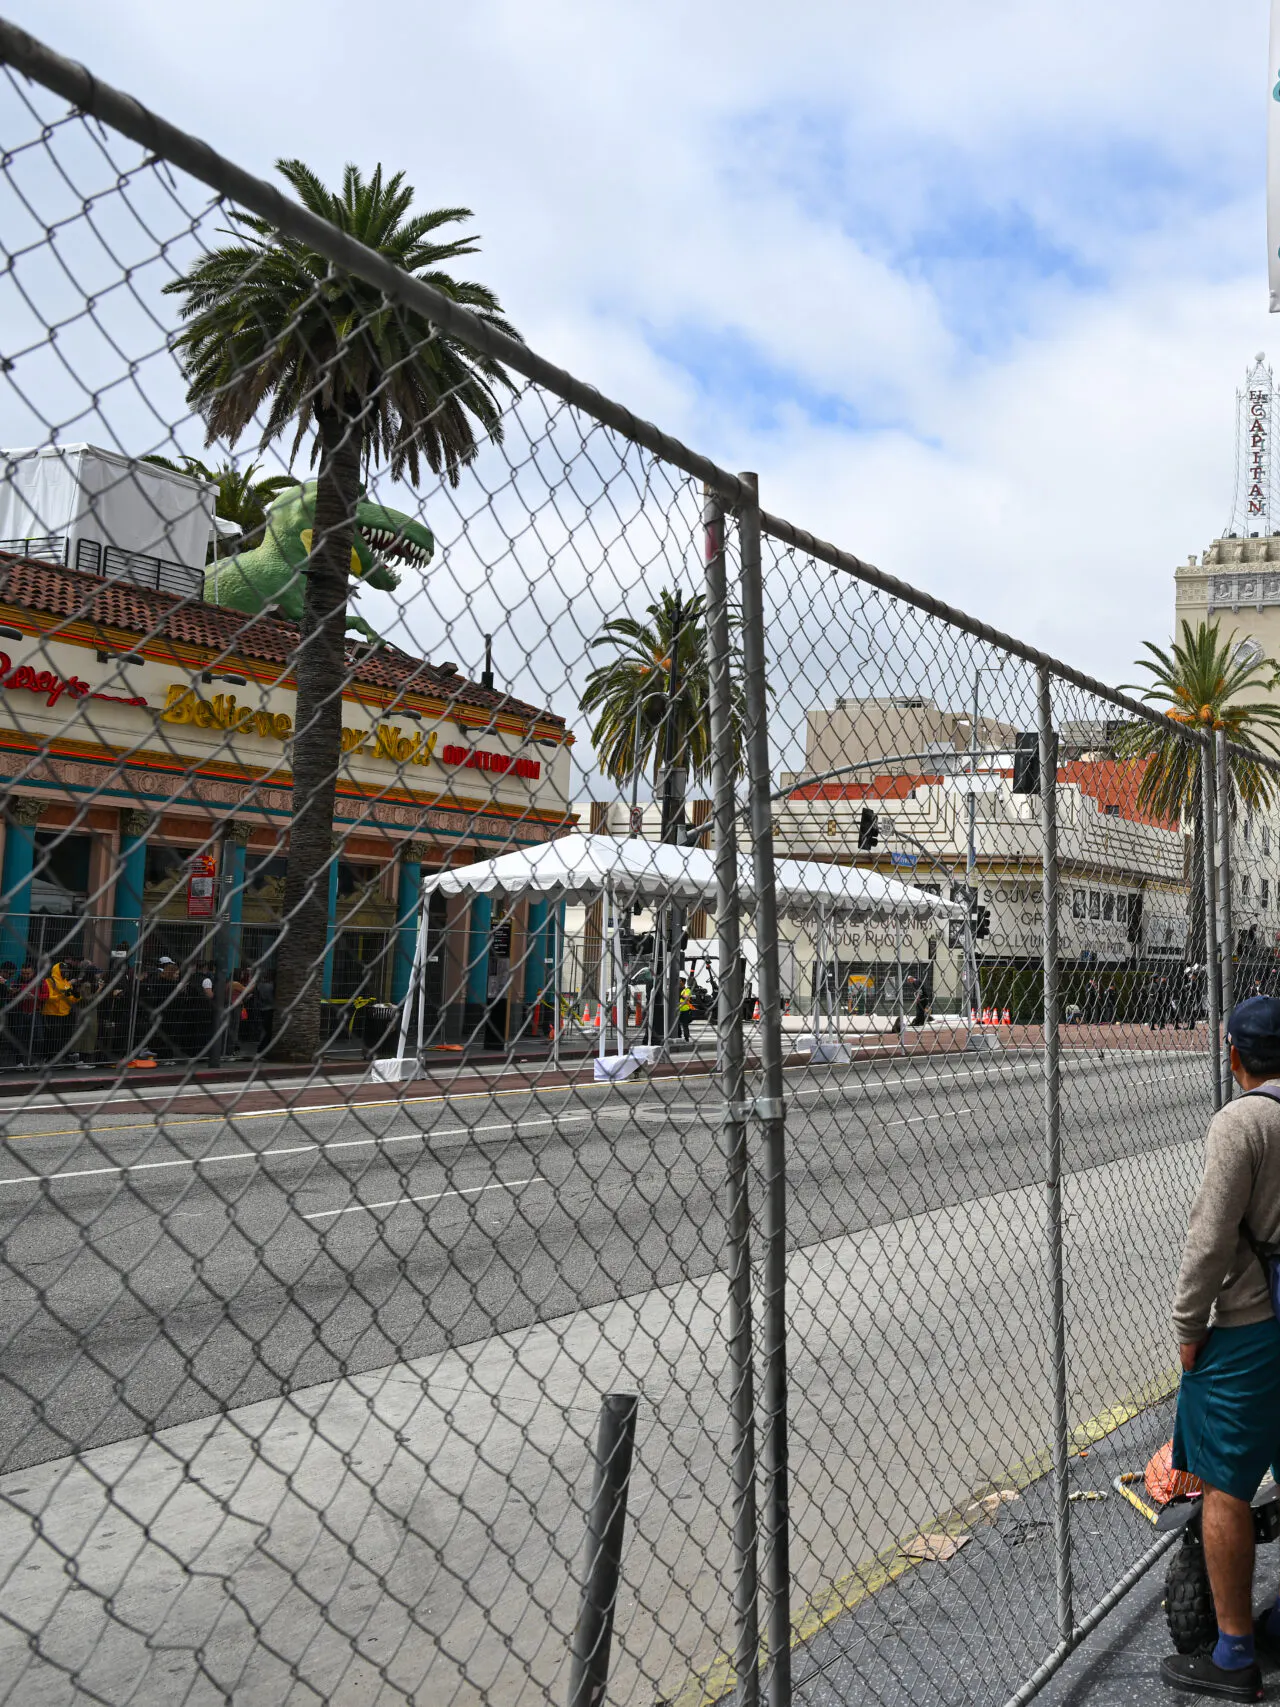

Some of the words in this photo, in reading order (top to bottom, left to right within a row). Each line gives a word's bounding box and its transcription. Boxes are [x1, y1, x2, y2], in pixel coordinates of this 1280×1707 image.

[1247, 404, 1265, 513] CAPITAN
[161, 683, 293, 741] Believe
[371, 724, 438, 767] Not!
